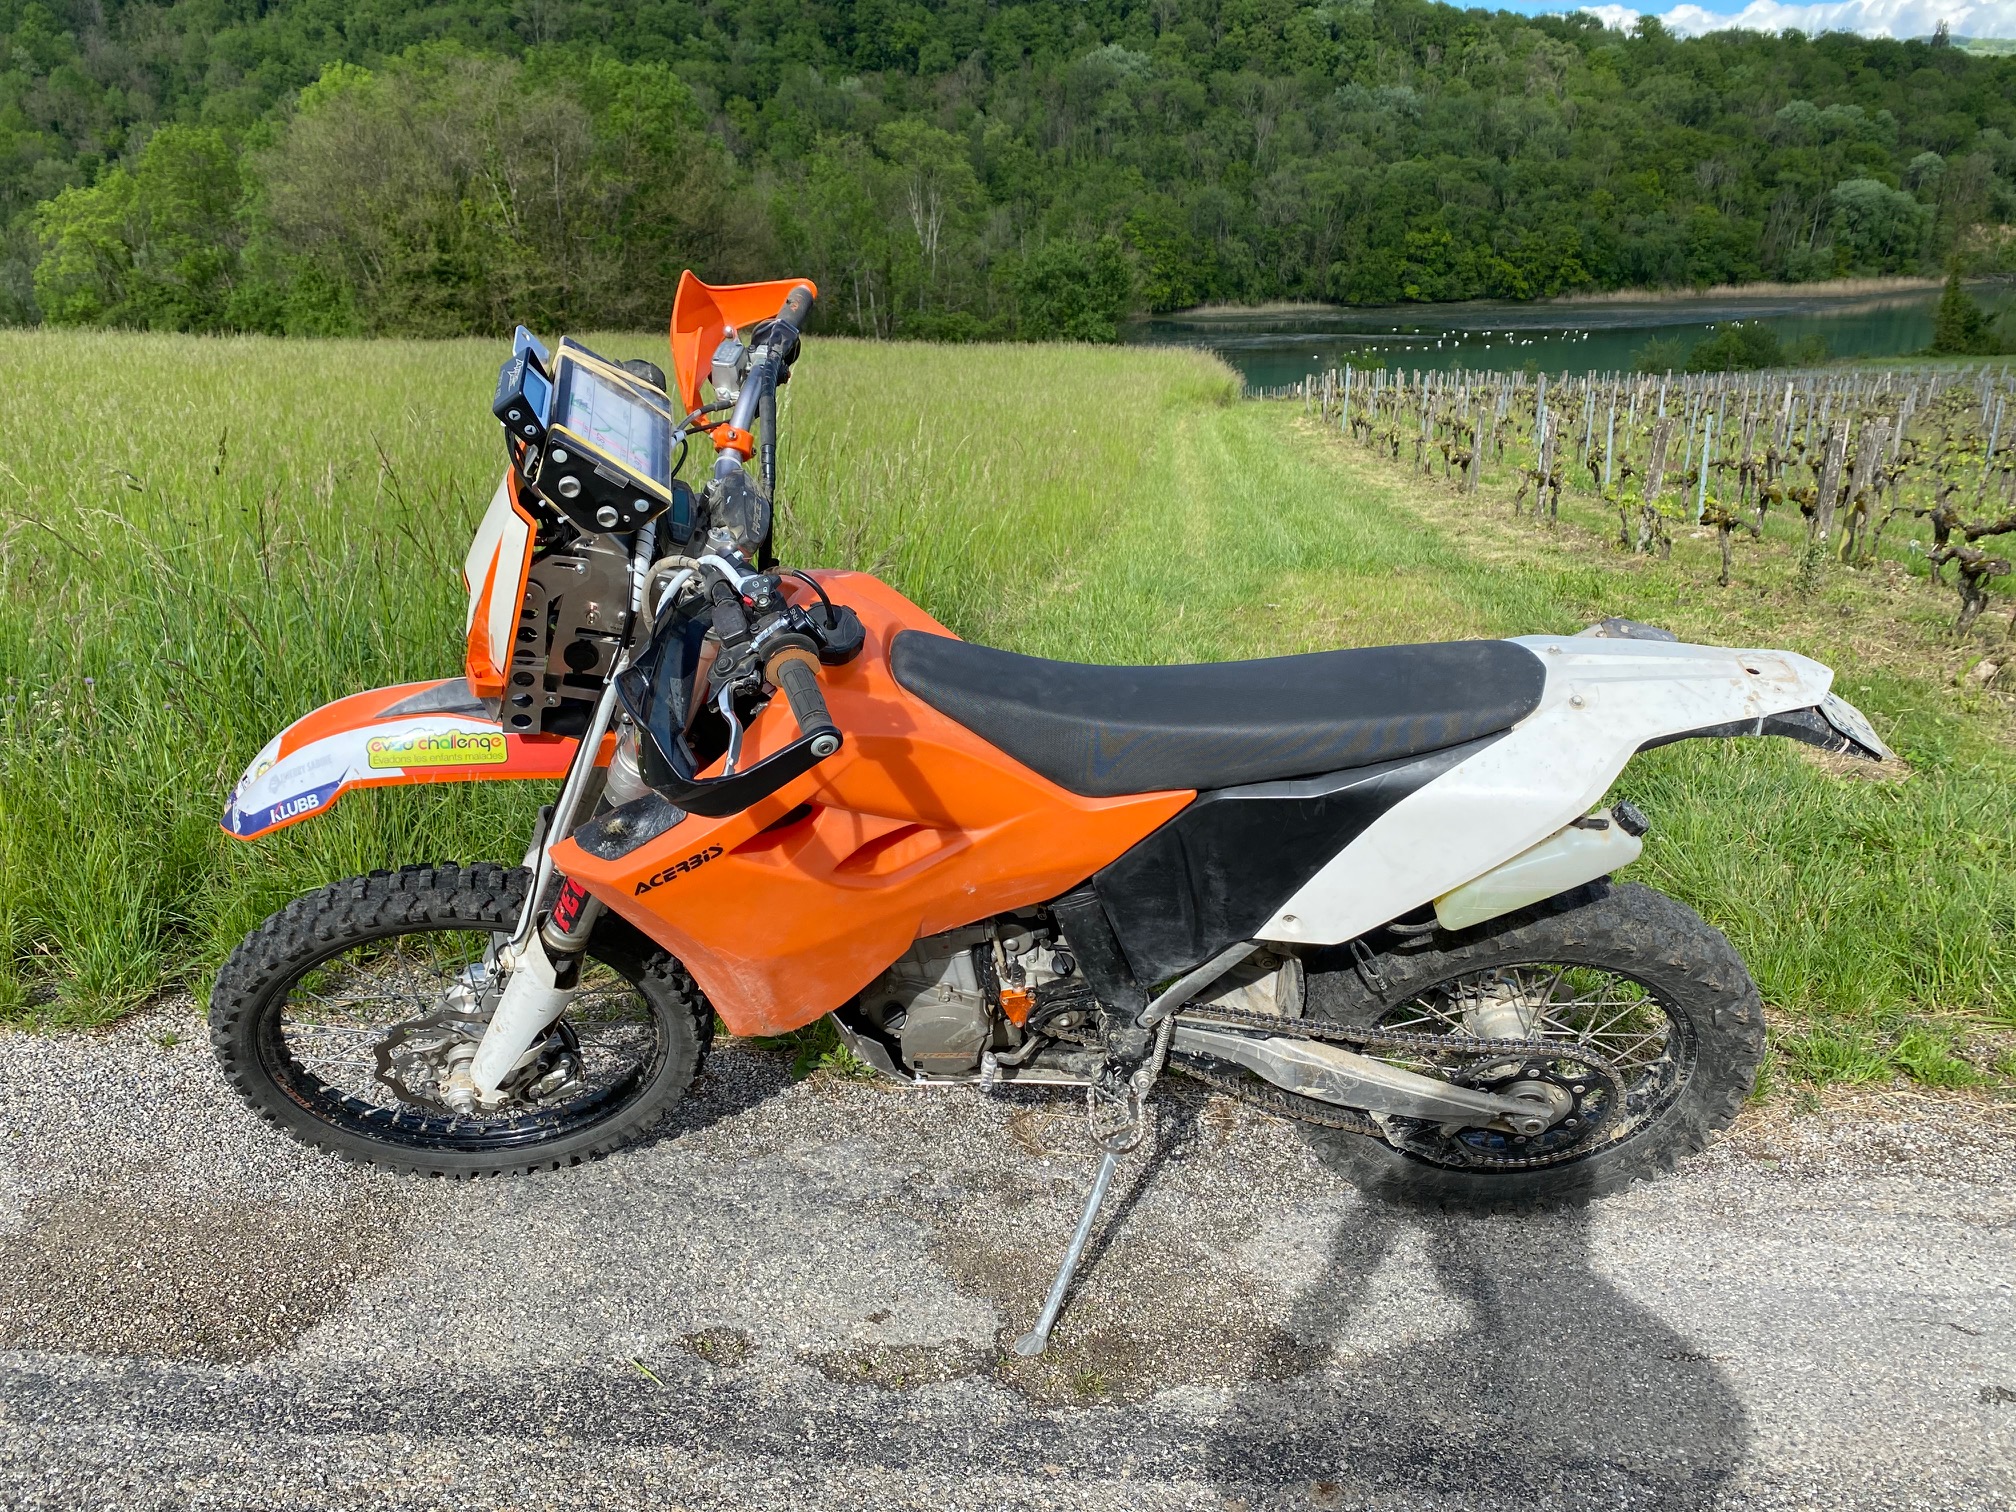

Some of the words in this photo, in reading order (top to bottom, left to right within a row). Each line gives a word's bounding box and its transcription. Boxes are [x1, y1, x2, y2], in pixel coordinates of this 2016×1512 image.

[418, 734, 502, 752] challenge
[372, 754, 412, 765] Évadons
[414, 754, 428, 763] les
[430, 752, 463, 762] enfants
[465, 751, 504, 761] malades
[270, 793, 320, 825] KLUBB
